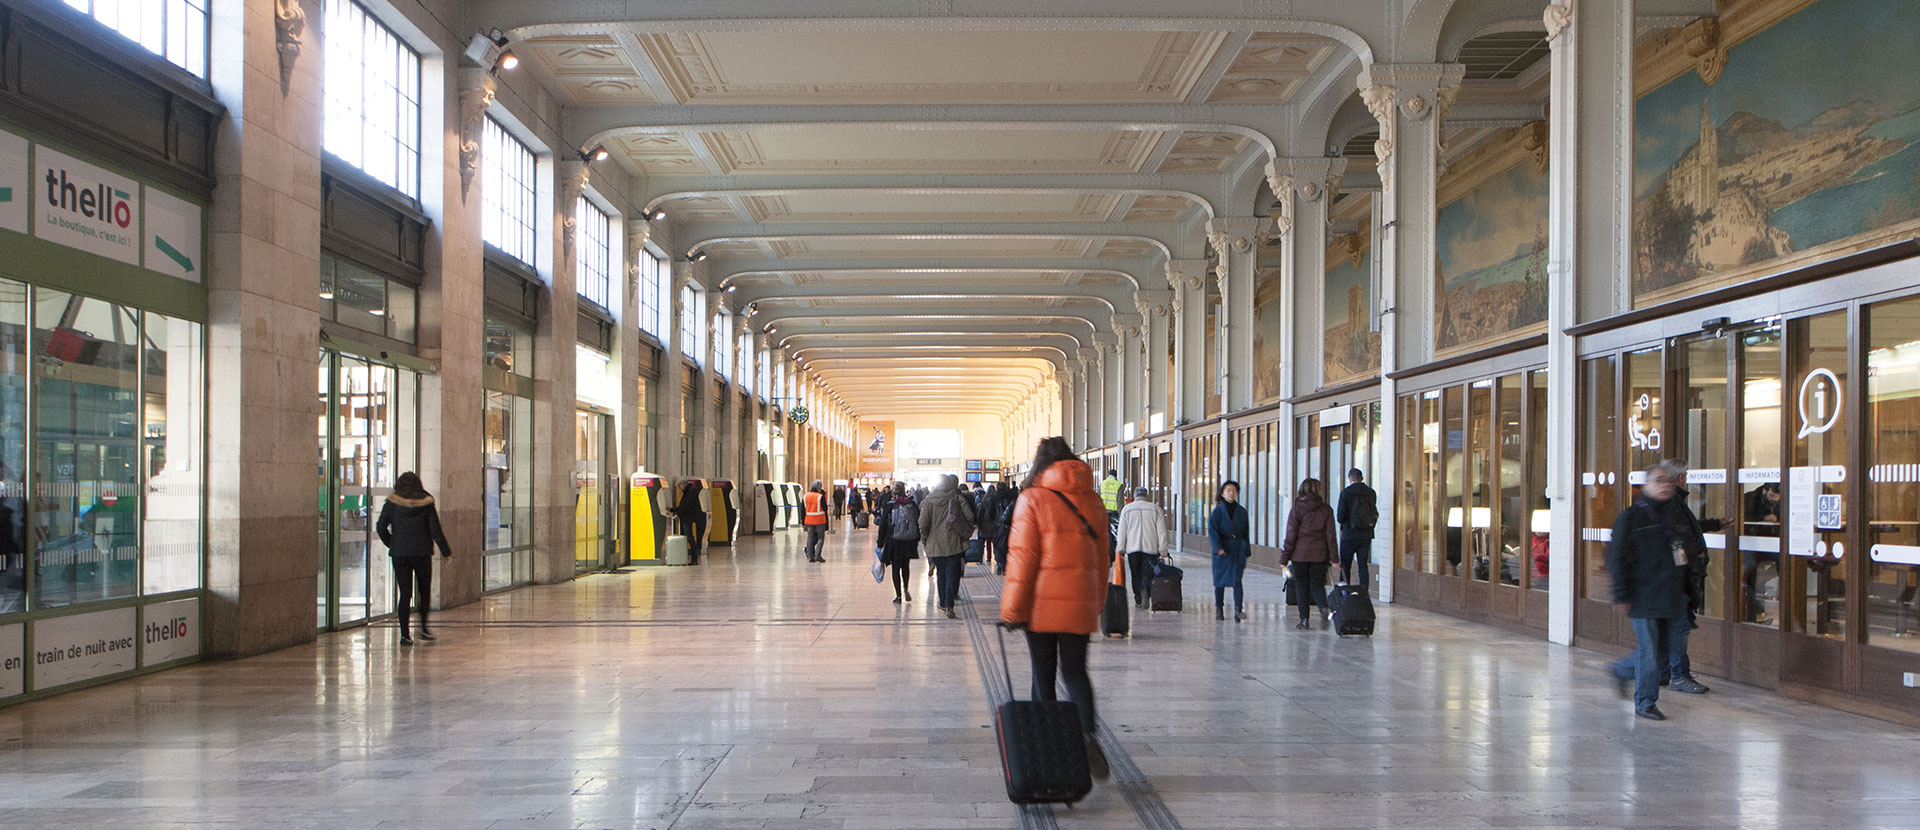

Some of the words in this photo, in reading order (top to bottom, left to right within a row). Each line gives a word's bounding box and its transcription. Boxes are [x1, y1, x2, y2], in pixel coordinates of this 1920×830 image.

[47, 213, 57, 225] La
[59, 217, 98, 238] boutique,
[1688, 472, 1724, 480] INFORMATION
[1744, 471, 1780, 479] INFORMATIO
[5, 656, 20, 670] en
[36, 648, 64, 665] train
[67, 644, 82, 659] de
[85, 640, 106, 655] nuit
[109, 636, 133, 652] avec
